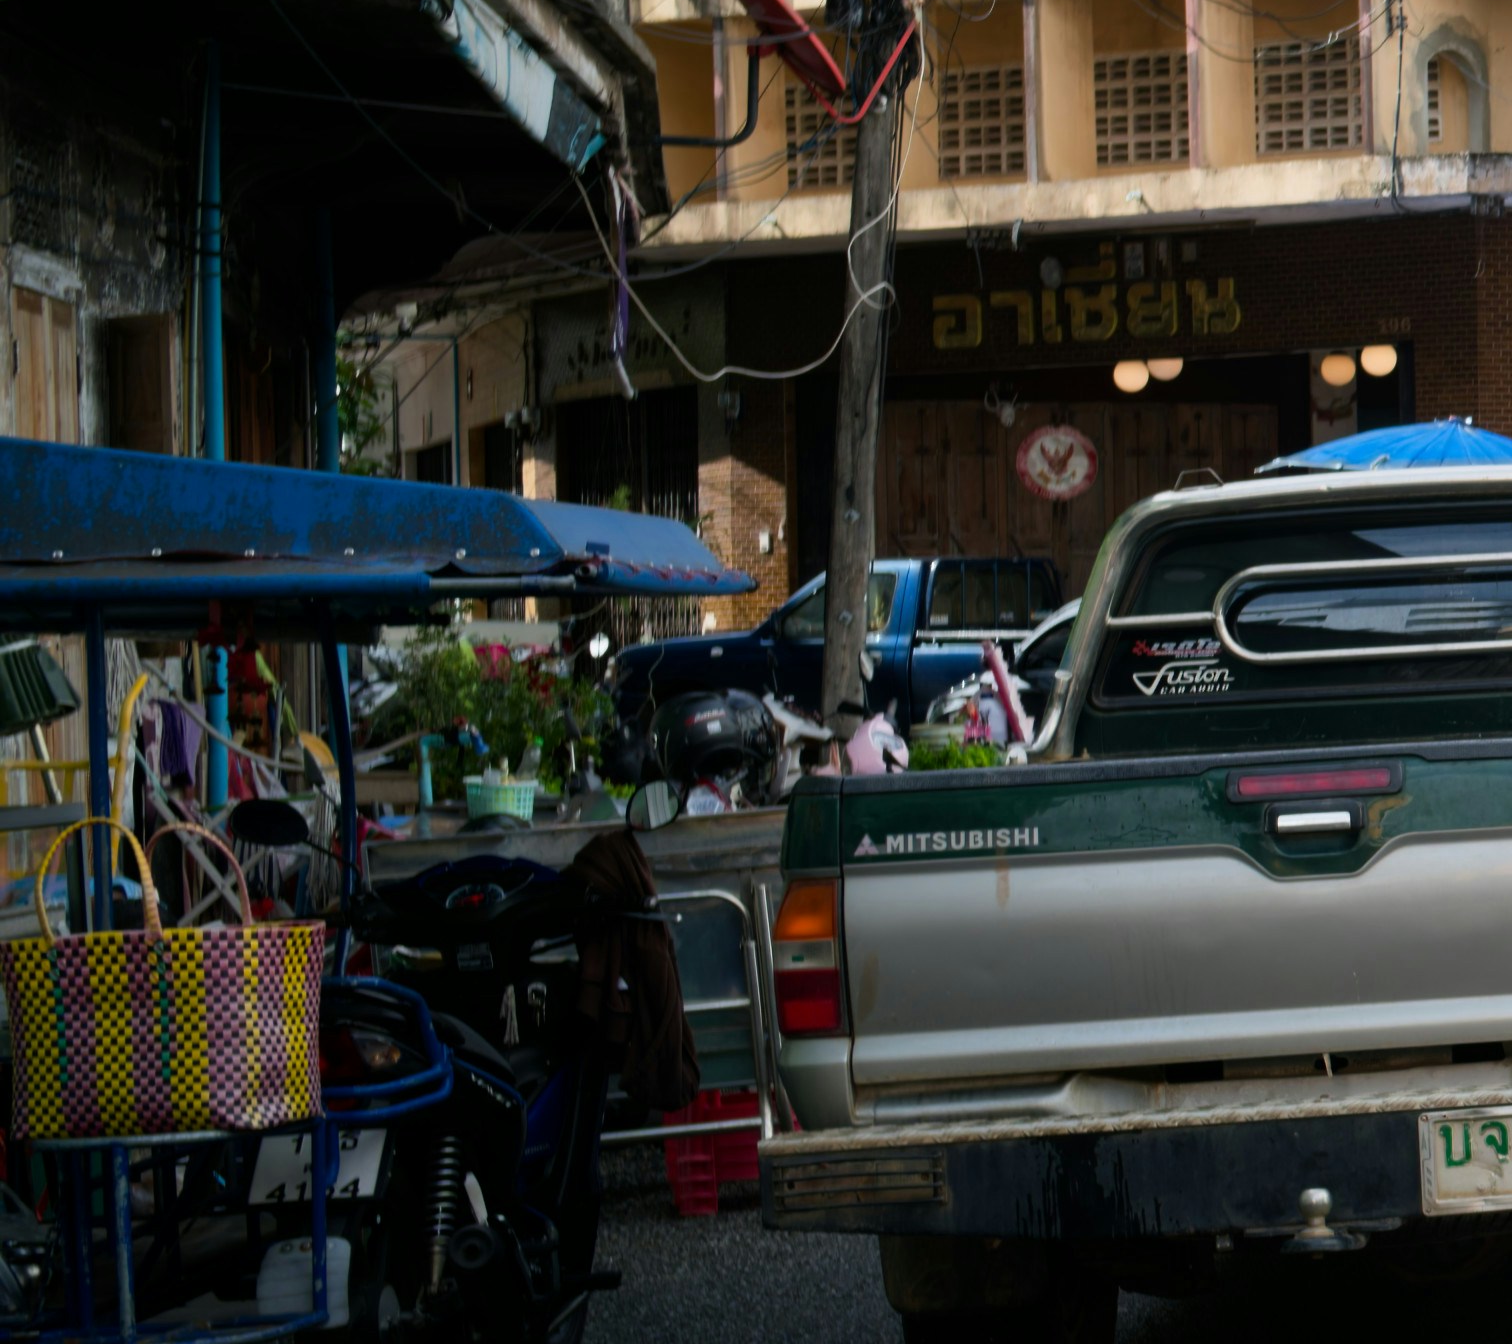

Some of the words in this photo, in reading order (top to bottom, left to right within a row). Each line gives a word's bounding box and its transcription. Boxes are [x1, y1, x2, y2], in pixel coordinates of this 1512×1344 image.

[1160, 685, 1186, 695] CAR
[1190, 683, 1230, 693] AUDIO
[886, 826, 1039, 854] MITSUBISHI
[1440, 1121, 1509, 1168] บจ
